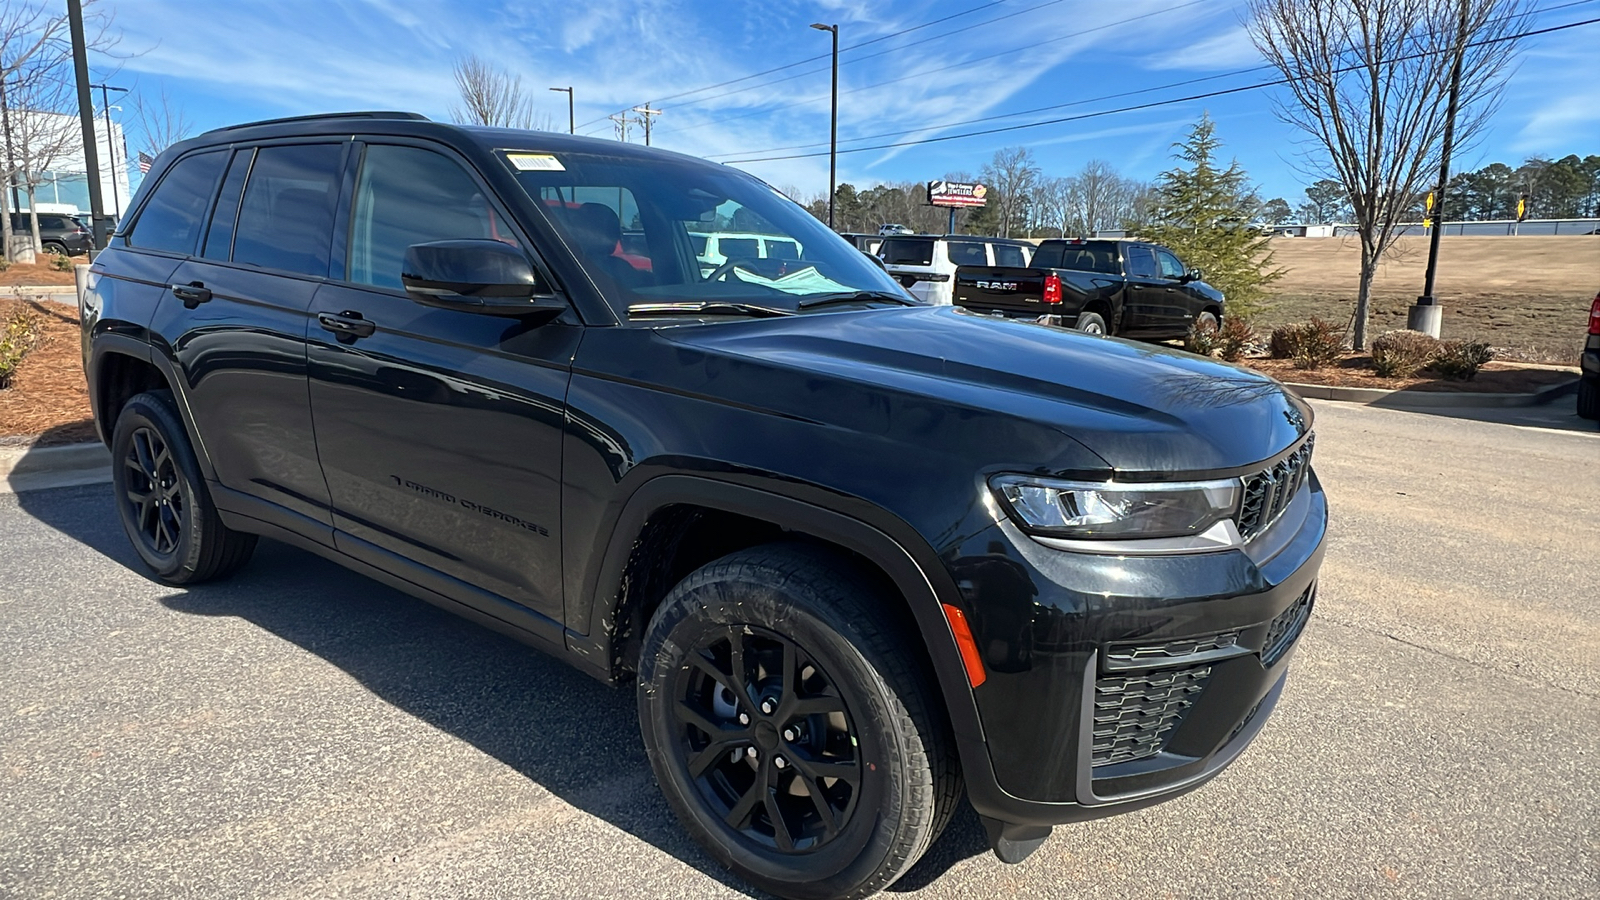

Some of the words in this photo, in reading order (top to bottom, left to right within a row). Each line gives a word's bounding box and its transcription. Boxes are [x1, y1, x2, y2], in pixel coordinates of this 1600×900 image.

[976, 281, 1017, 291] RAM
[405, 480, 456, 504] GRAND
[459, 499, 550, 538] CHEROKEE
